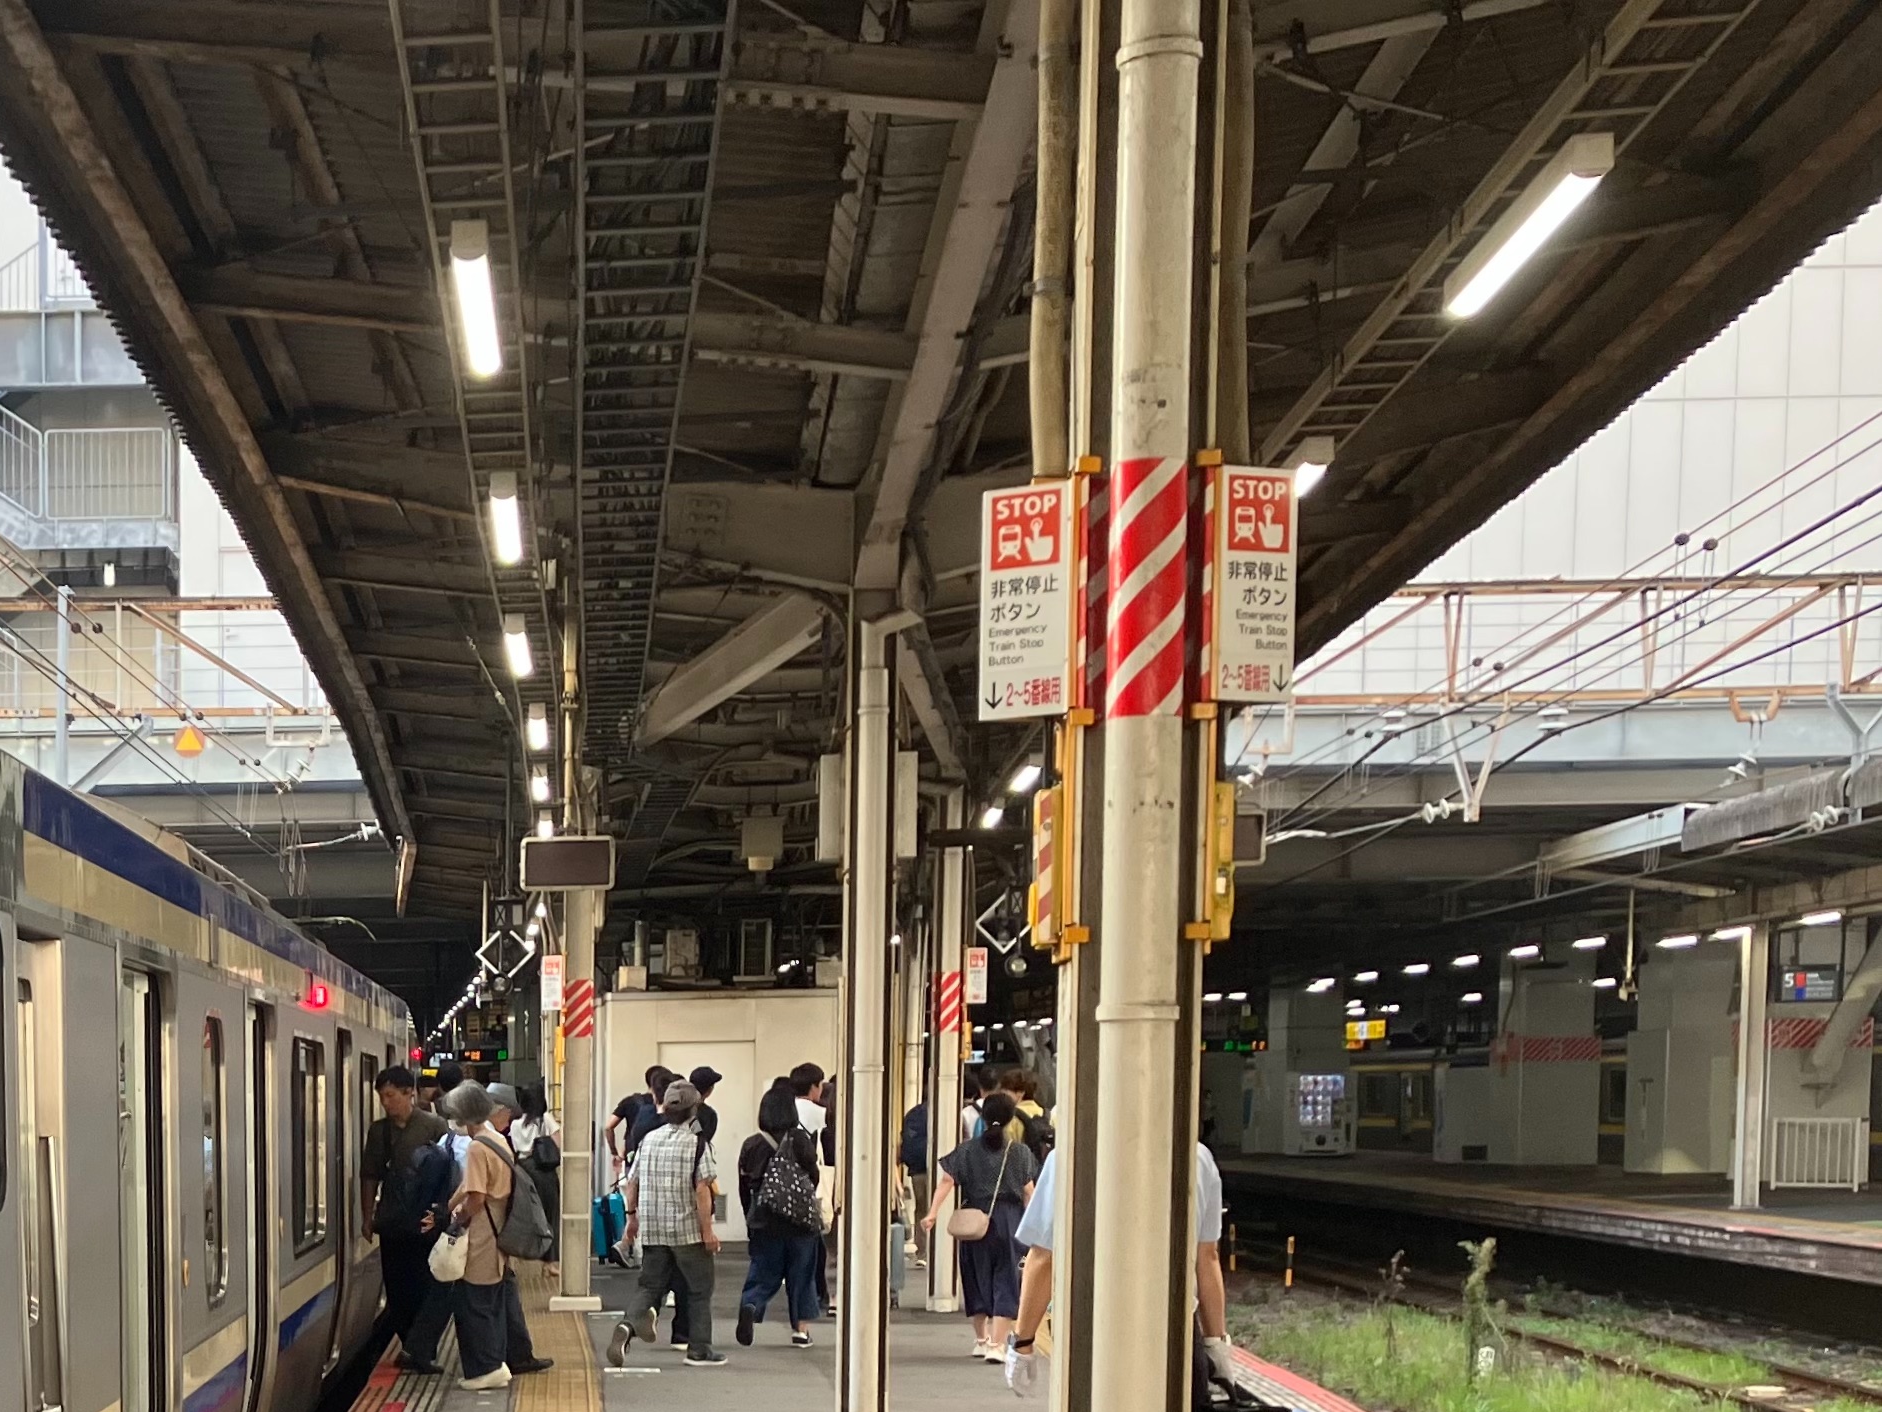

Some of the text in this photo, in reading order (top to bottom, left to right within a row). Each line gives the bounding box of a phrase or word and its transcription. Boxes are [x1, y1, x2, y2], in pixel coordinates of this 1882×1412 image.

[1232, 479, 1288, 500] STOP
[996, 493, 1057, 520] STOP
[1227, 561, 1288, 582] 非常停止
[991, 573, 1059, 599] 非常停止
[1242, 586, 1288, 606] ボタン
[990, 603, 1041, 623] ボタン
[1235, 608, 1288, 622] Emergency
[988, 624, 1048, 638] Emergency
[1239, 623, 1288, 637] Train Stop
[989, 638, 1044, 652] Train Stop
[1255, 638, 1288, 650] Button
[988, 655, 1024, 667] Button
[1784, 972, 1794, 988] 5
